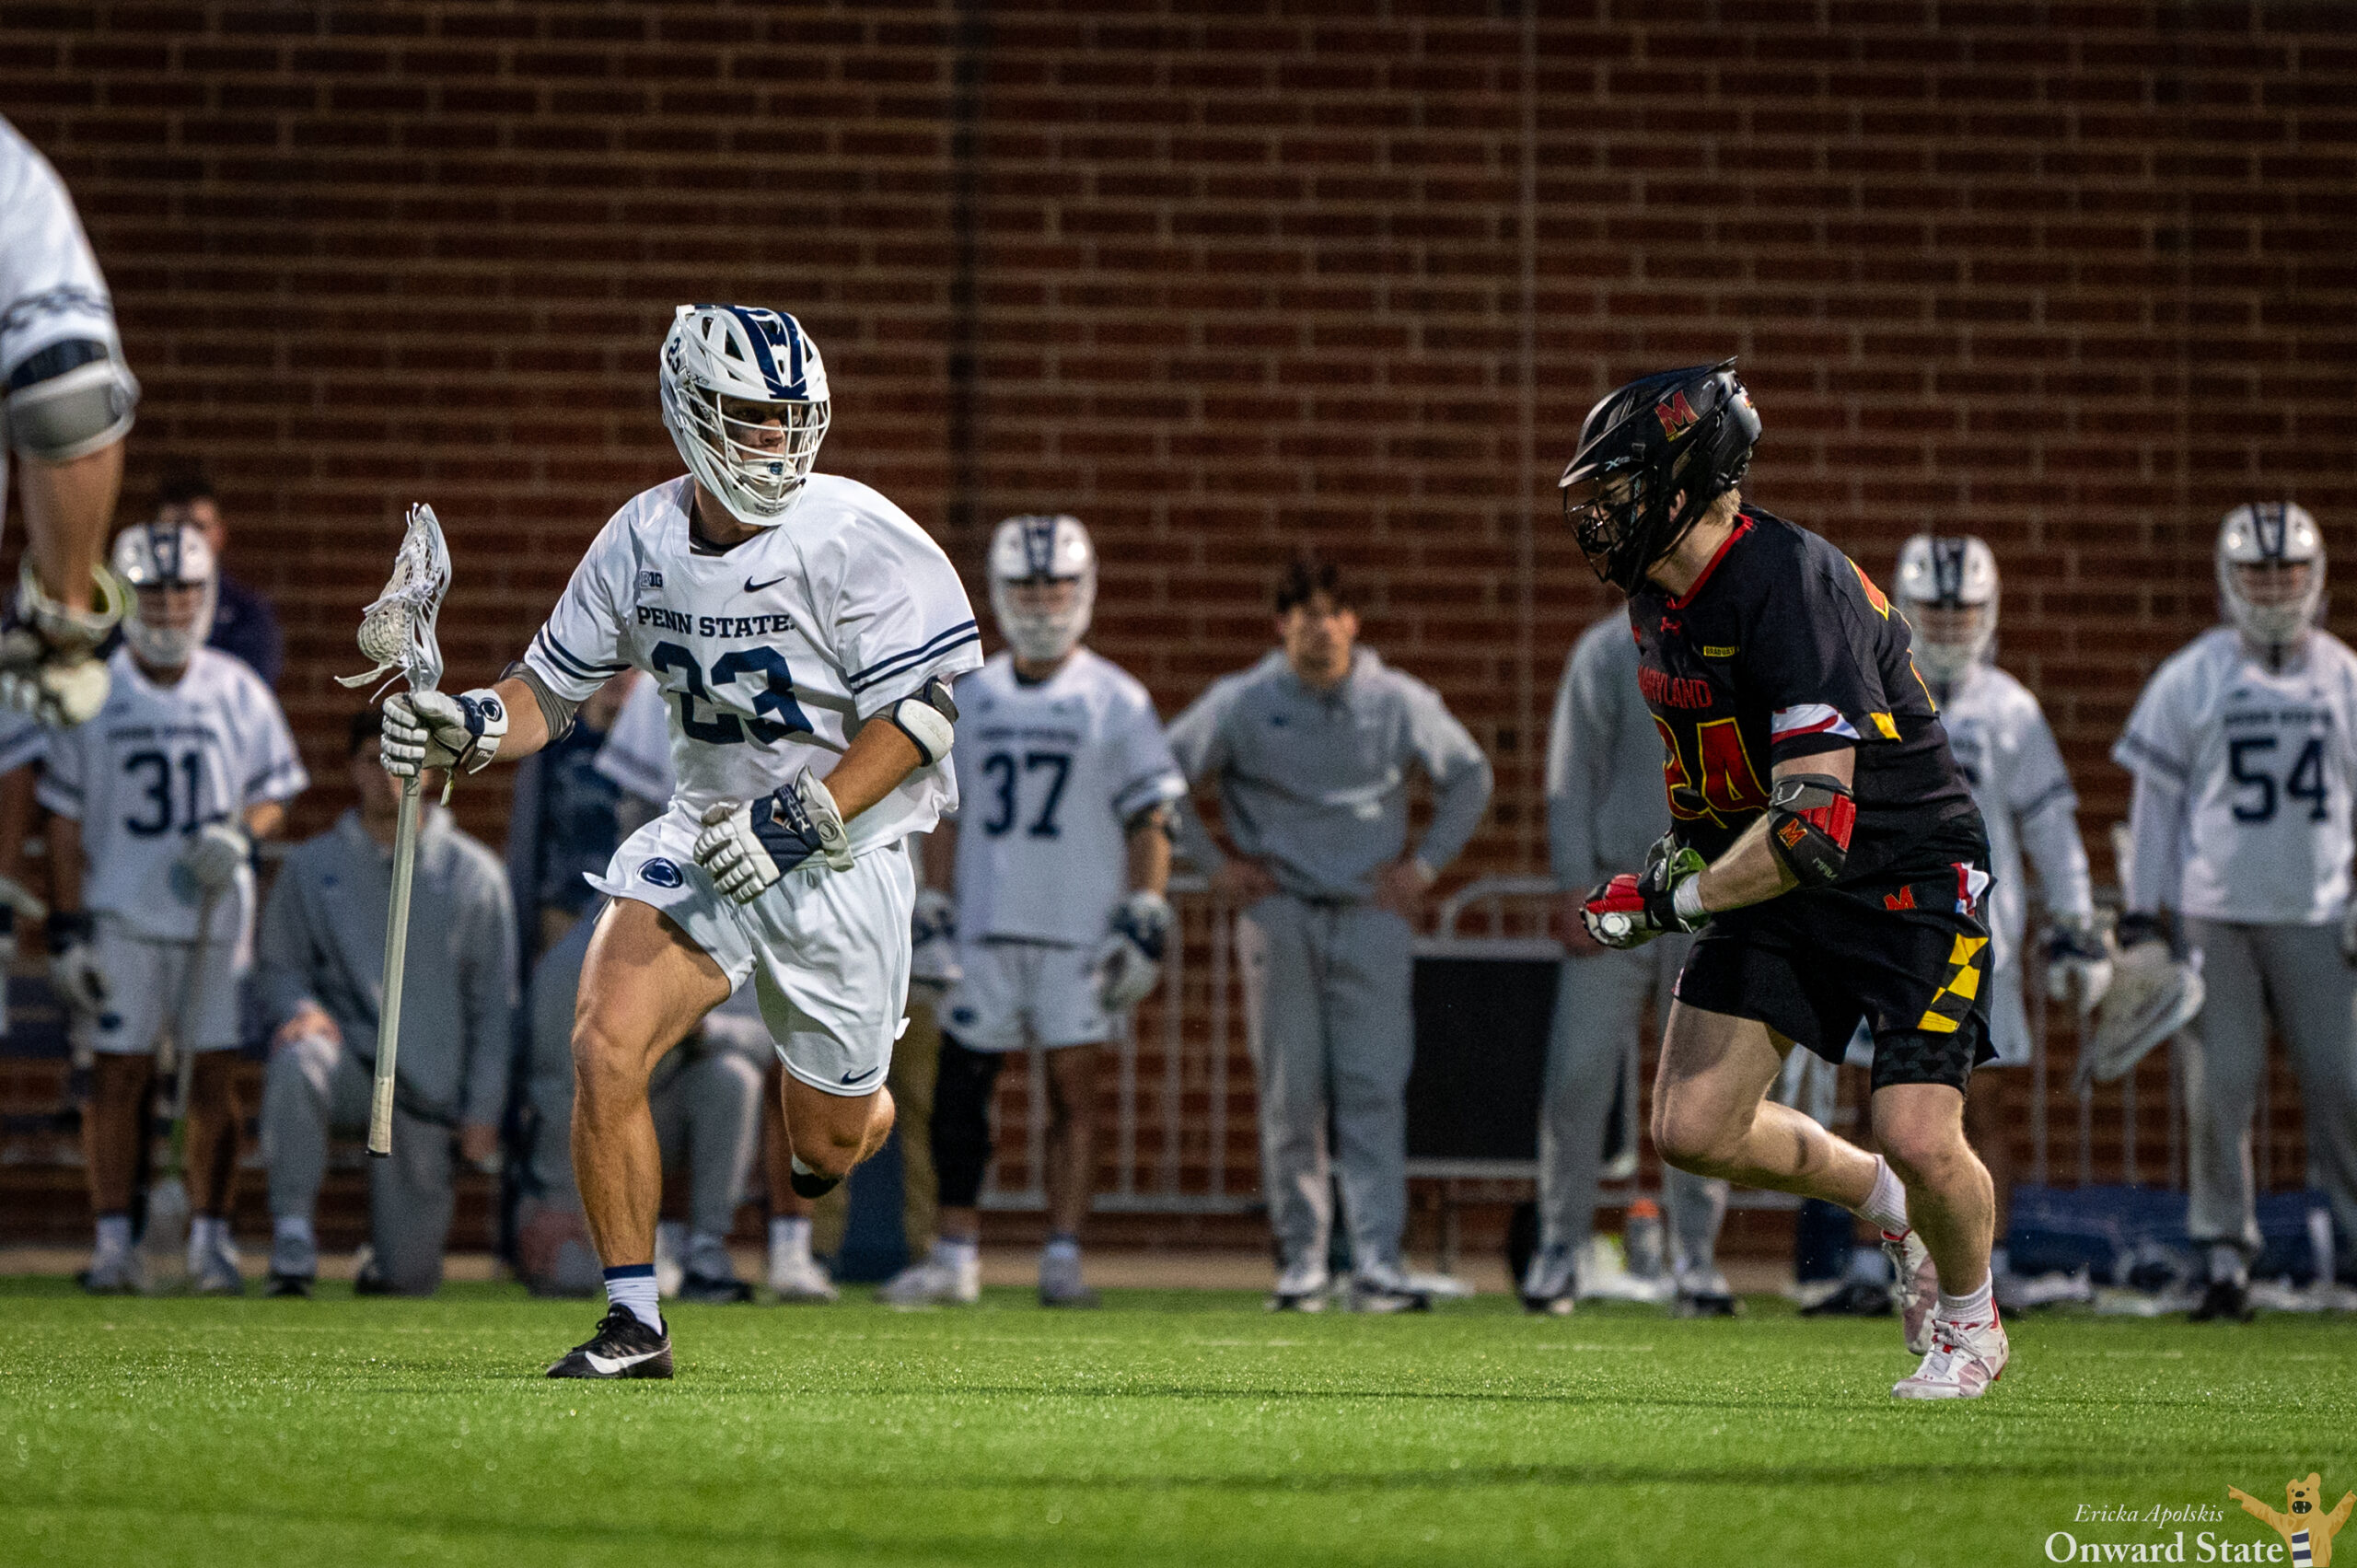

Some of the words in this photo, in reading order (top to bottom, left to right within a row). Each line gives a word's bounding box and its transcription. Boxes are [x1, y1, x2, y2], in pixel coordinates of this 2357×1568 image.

[1654, 389, 1701, 437] M
[635, 605, 693, 635] PENN
[650, 640, 815, 745] 23
[123, 749, 201, 838] 31
[981, 749, 1073, 839] 37
[2229, 737, 2328, 824] 54
